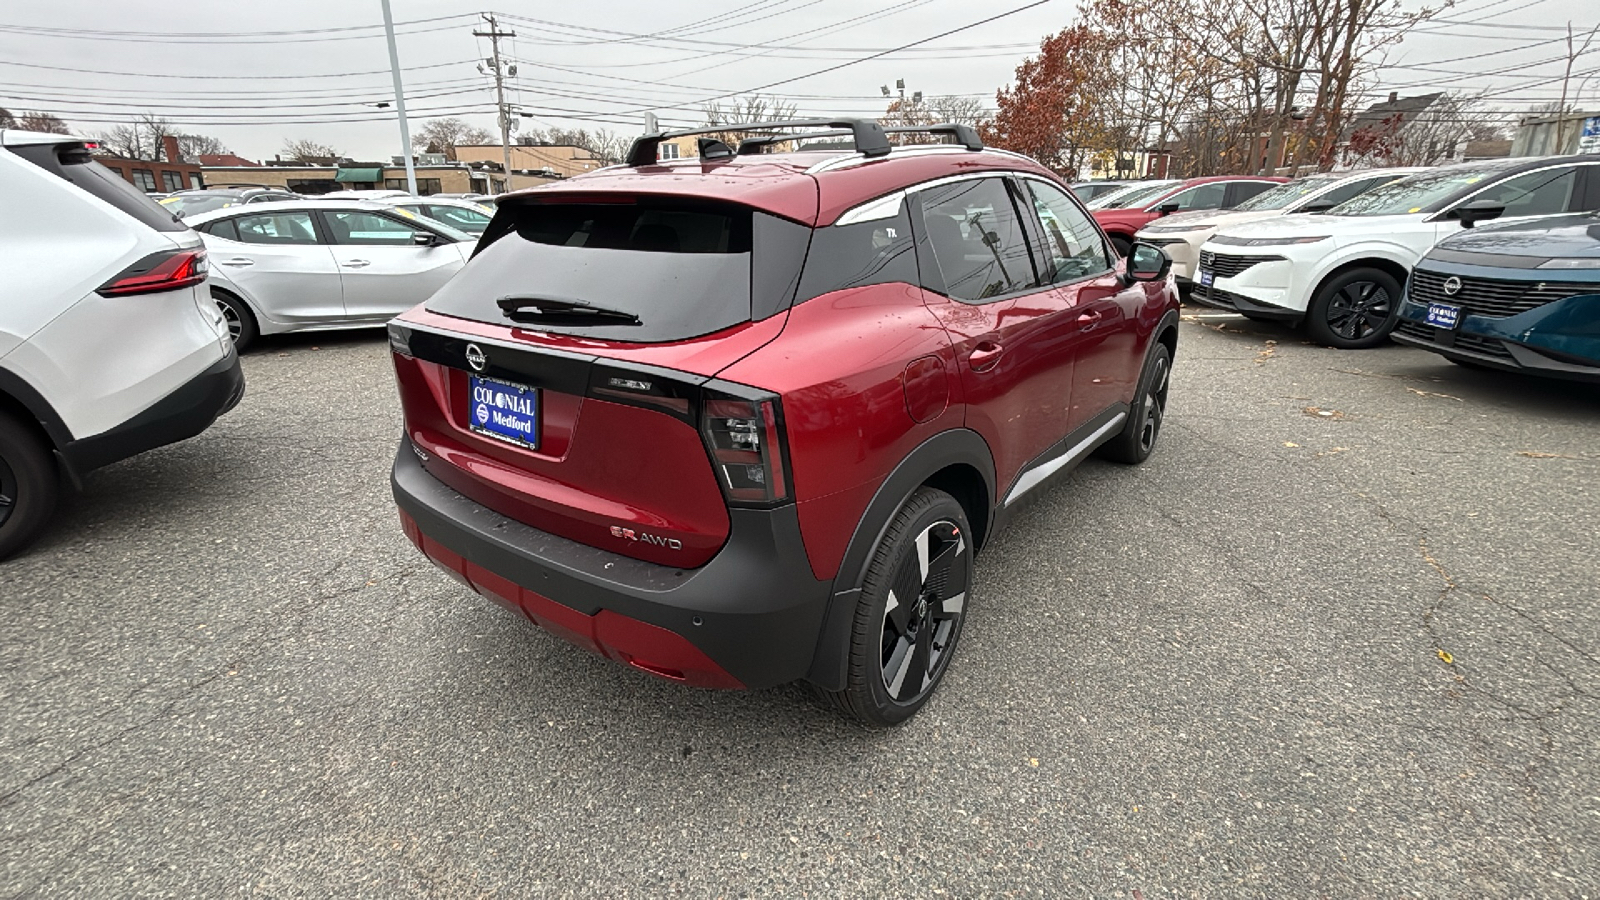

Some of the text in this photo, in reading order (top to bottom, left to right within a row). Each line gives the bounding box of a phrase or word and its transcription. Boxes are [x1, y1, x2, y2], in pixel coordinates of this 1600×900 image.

[474, 386, 534, 416] COLONIAL
[492, 410, 531, 433] Medford
[640, 532, 682, 550] AWD
